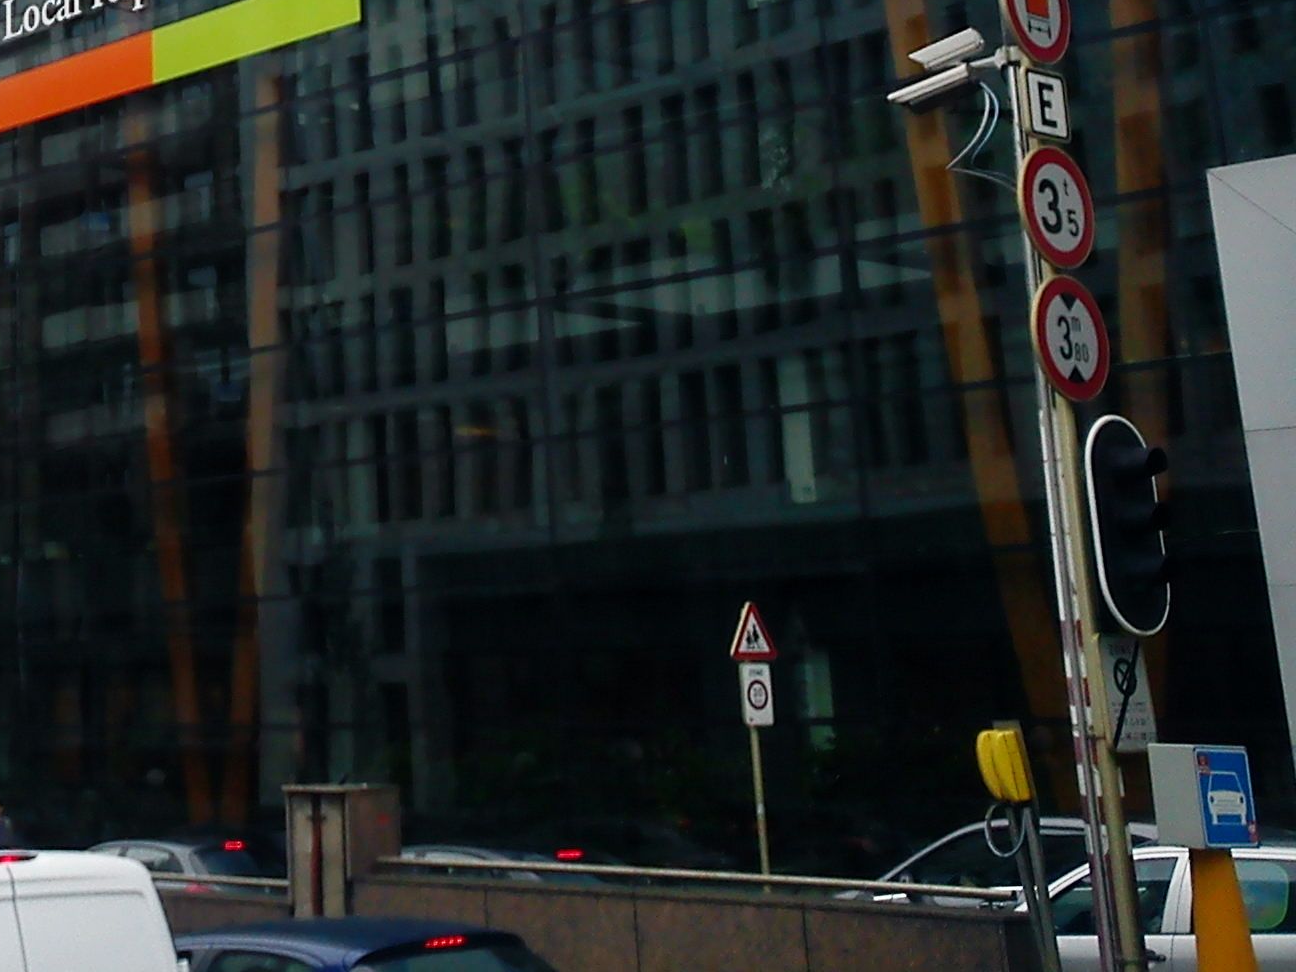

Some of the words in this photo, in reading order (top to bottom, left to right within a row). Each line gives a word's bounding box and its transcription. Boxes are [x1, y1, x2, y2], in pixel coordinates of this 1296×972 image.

[1037, 82, 1058, 128] E
[1039, 179, 1062, 234] 3
[1067, 209, 1079, 237] 5
[1058, 316, 1073, 360] 3
